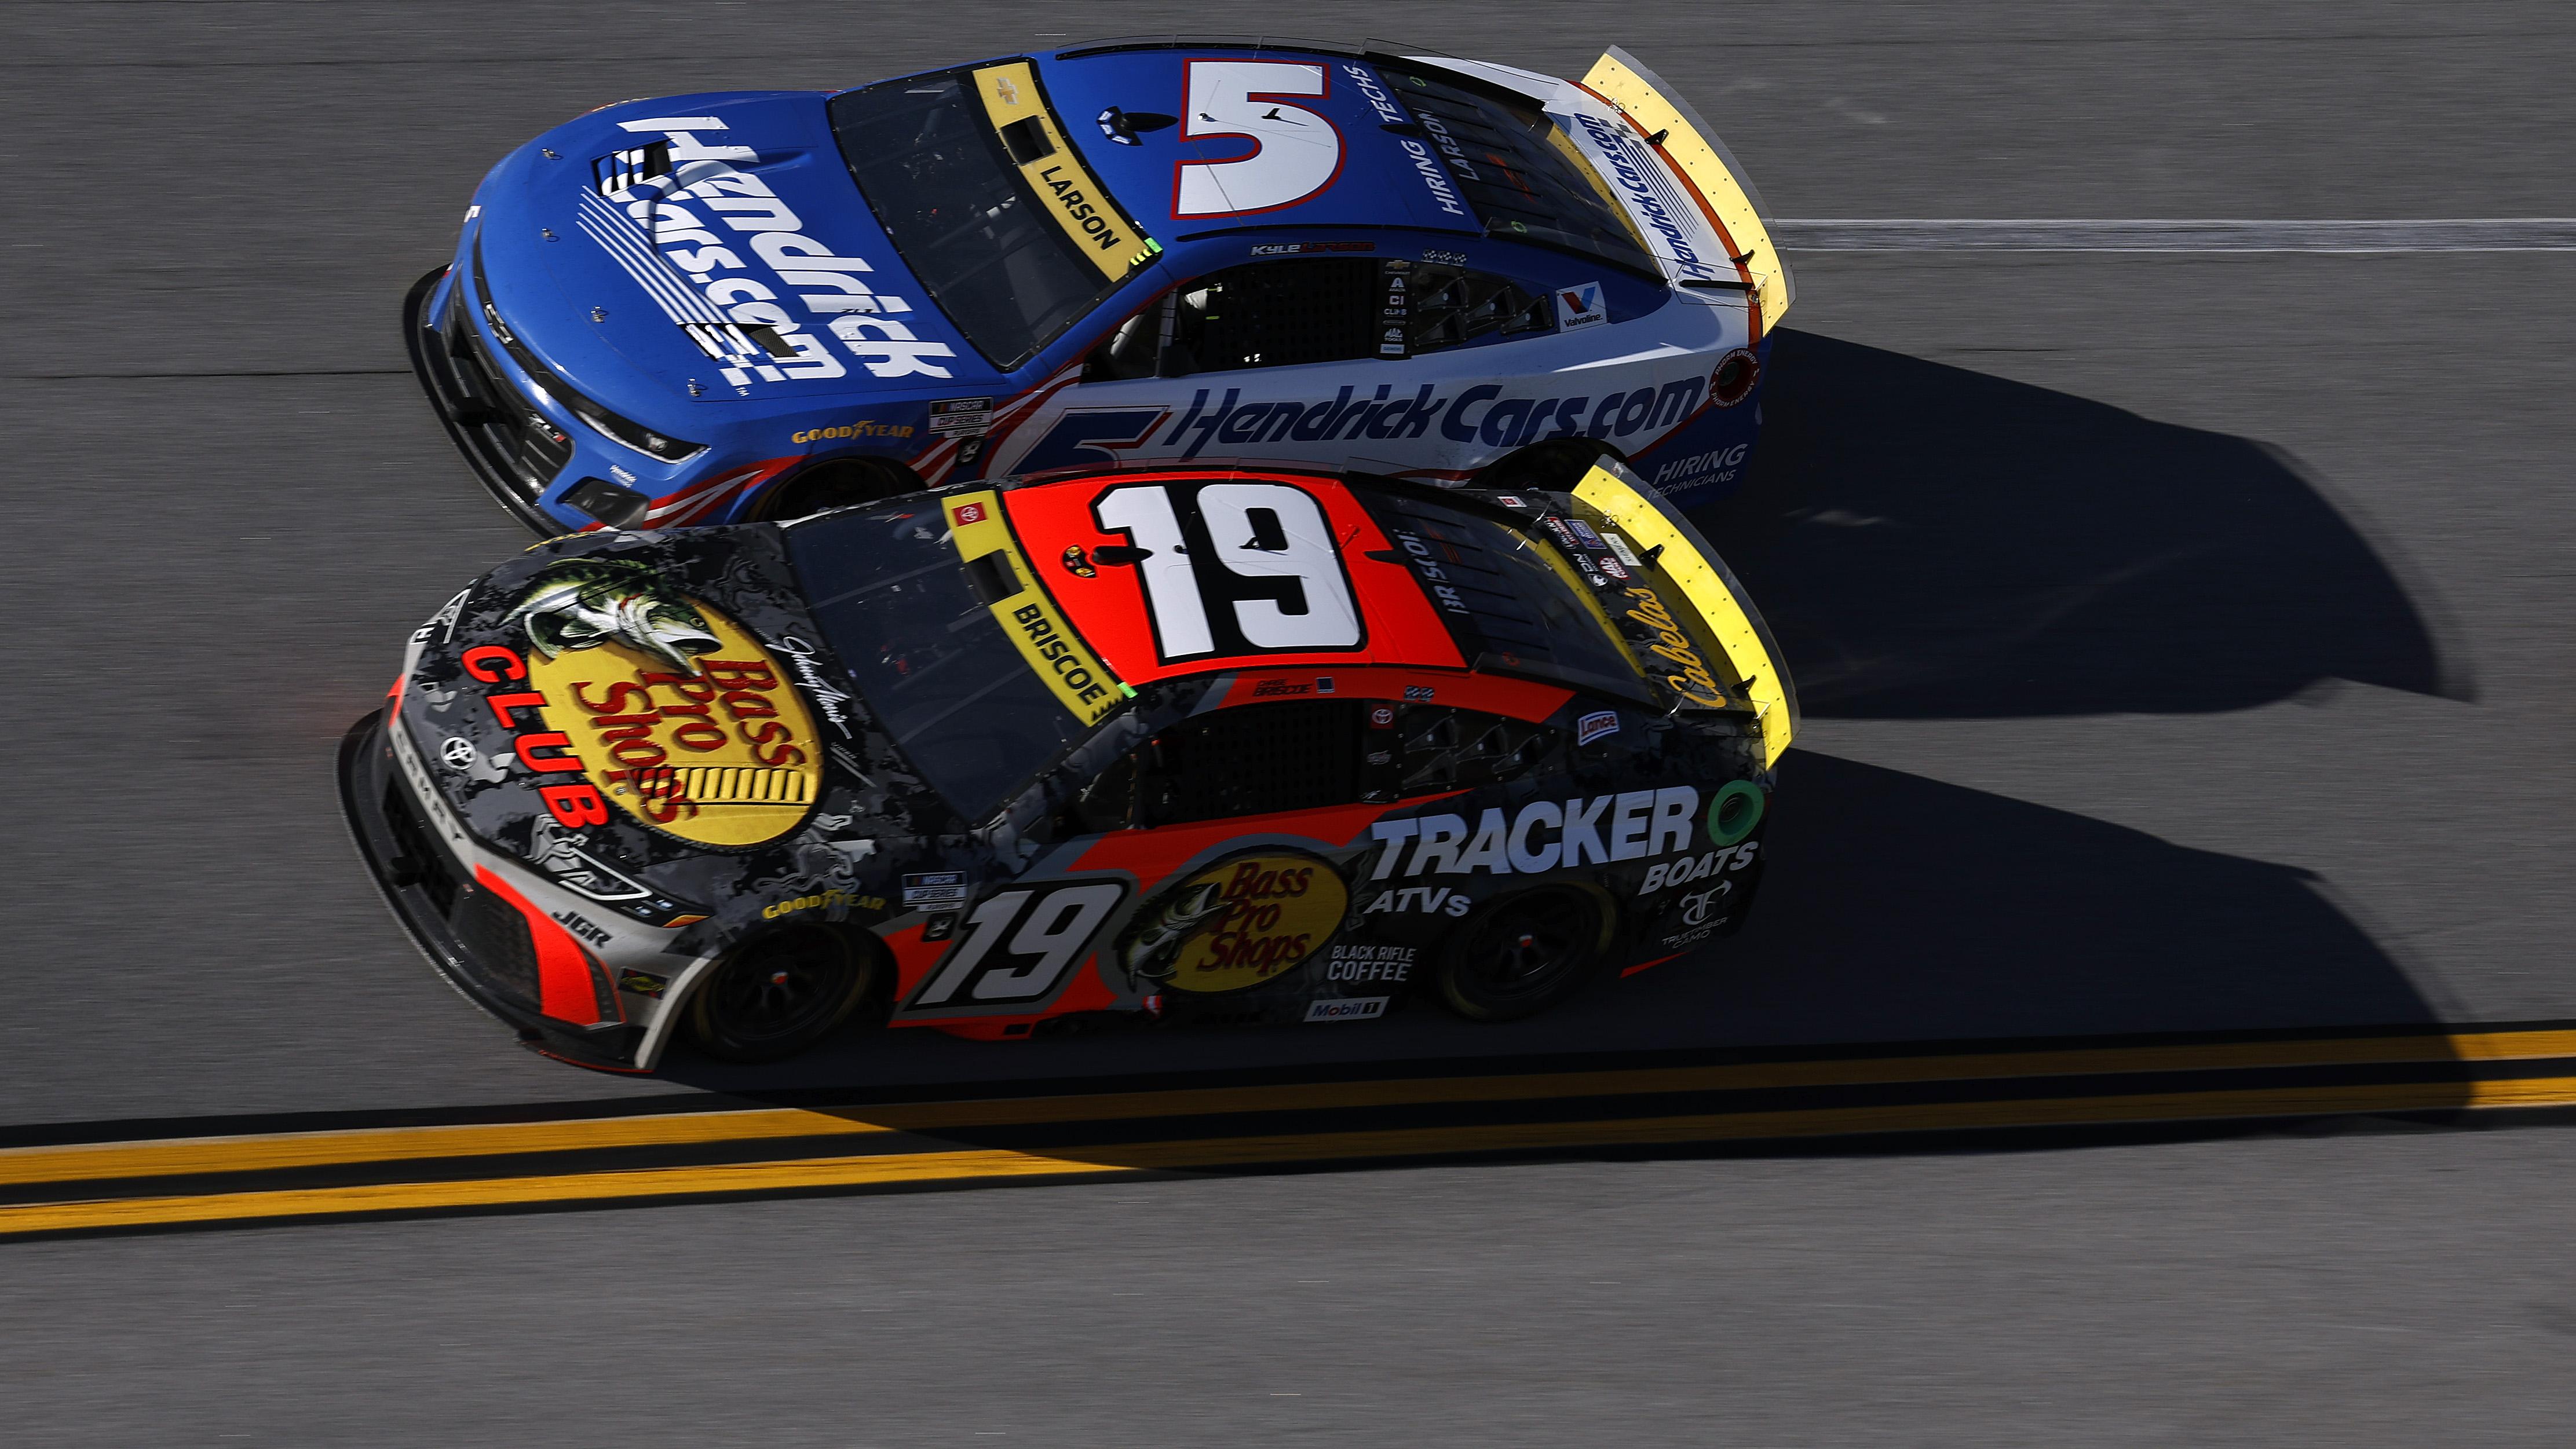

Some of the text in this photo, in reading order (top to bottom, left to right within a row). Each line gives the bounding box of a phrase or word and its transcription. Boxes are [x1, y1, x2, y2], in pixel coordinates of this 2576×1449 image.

[1170, 58, 1347, 219] 5
[1343, 65, 1464, 215] HIRING TECHS
[1418, 109, 1479, 181] LARSON
[1040, 166, 1121, 250] LARSON
[601, 172, 847, 378] Cars.com
[617, 116, 956, 378] Hendrick
[792, 420, 914, 444] GOODYEAR
[1647, 470, 1736, 499] TECHNICIANS
[1653, 444, 1748, 485] HIRING
[1095, 484, 1361, 658] 19
[1013, 603, 1107, 706] BRISCOE
[1624, 587, 1727, 707] Cabela's
[462, 646, 609, 829] CLUB
[639, 667, 729, 752] Pro
[700, 659, 807, 769] Bass
[1581, 716, 1615, 737] Lance
[570, 681, 700, 824] Shops
[1371, 785, 1700, 880] TRACKER
[1220, 861, 1313, 899] Bass
[1638, 841, 1760, 895] BOATS
[551, 910, 614, 948] JGR
[762, 888, 887, 920] GOODYEAR
[1210, 899, 1280, 933] Pro
[1363, 887, 1472, 917] ATVs
[916, 884, 1122, 1005] 19
[1197, 931, 1311, 976] Shops
[1327, 960, 1412, 982] COFFEE
[1332, 945, 1417, 963] BLACK RIFLE
[1672, 930, 1711, 949] CAMO
[1313, 1002, 1378, 1018] Mobil 1
